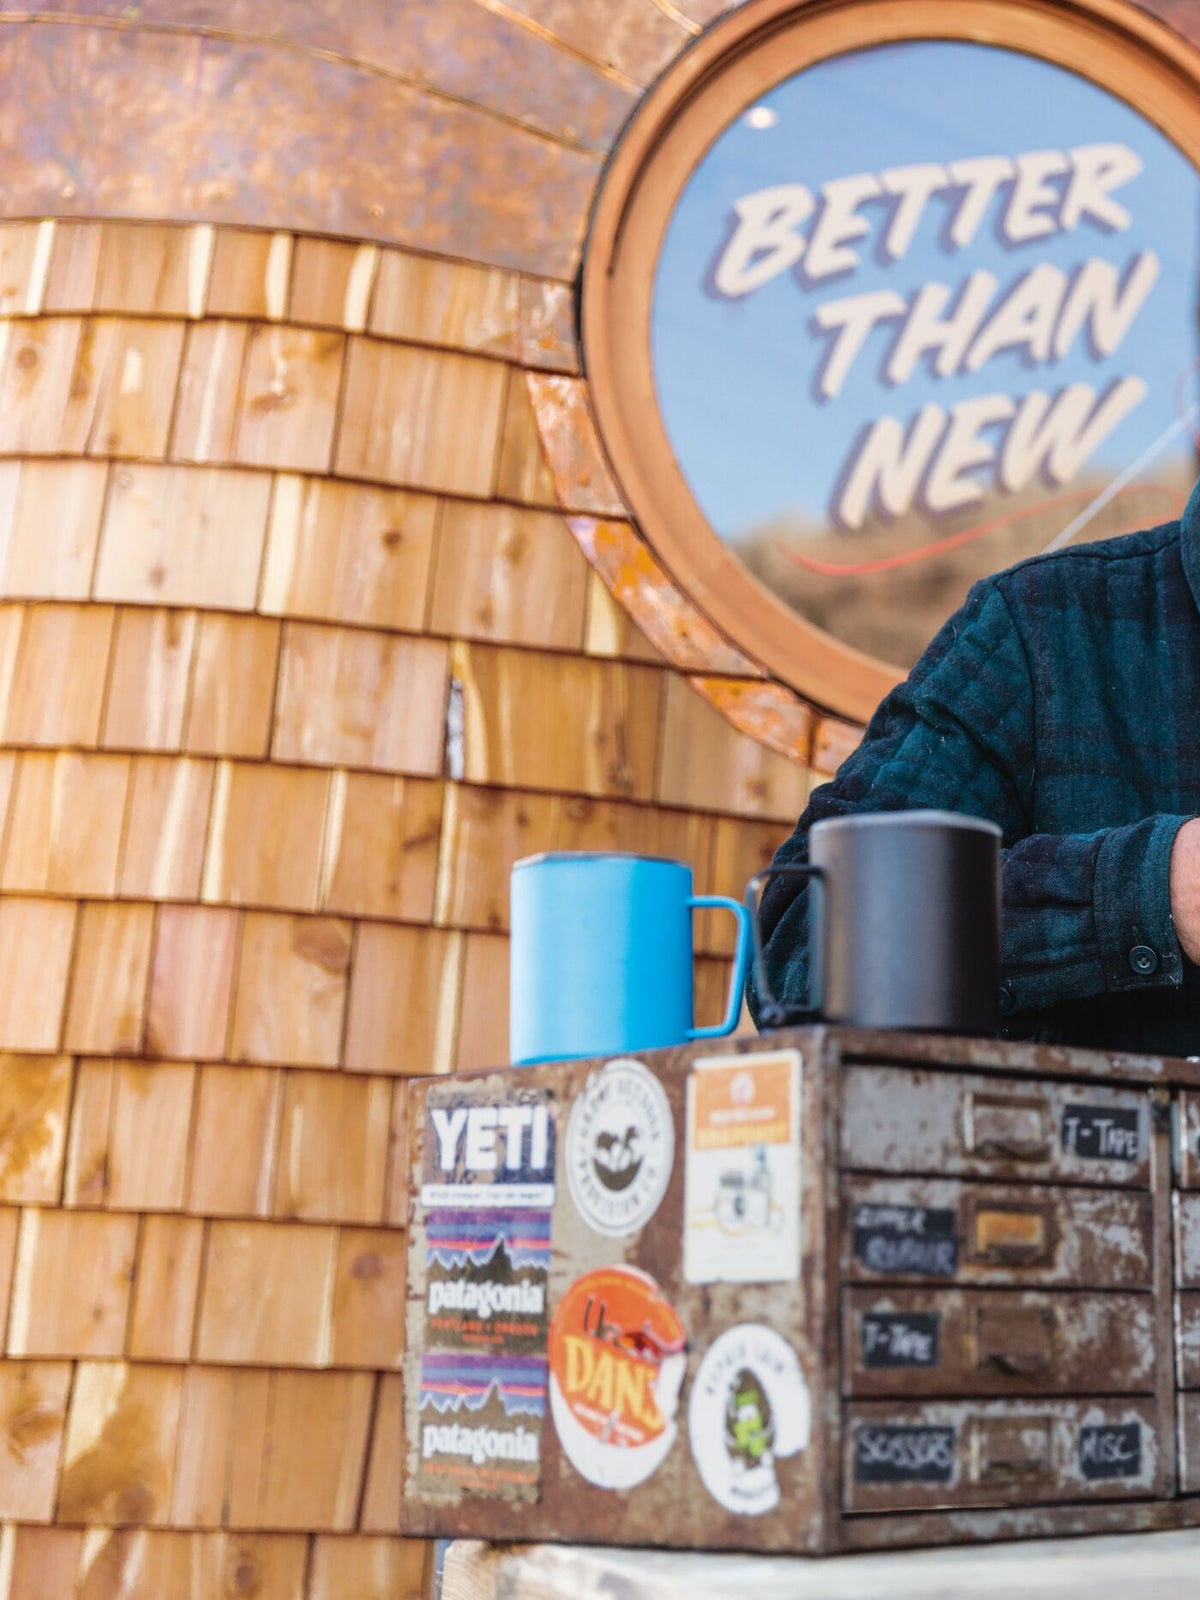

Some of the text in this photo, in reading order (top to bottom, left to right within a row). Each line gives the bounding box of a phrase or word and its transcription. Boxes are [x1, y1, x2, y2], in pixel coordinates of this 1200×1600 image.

[708, 143, 1143, 299] BETTER
[810, 249, 1160, 402] THAN
[832, 376, 1147, 531] NEW
[430, 1105, 550, 1171] YETI
[428, 1278, 544, 1318] patagonia
[422, 1423, 538, 1465] patagonia
